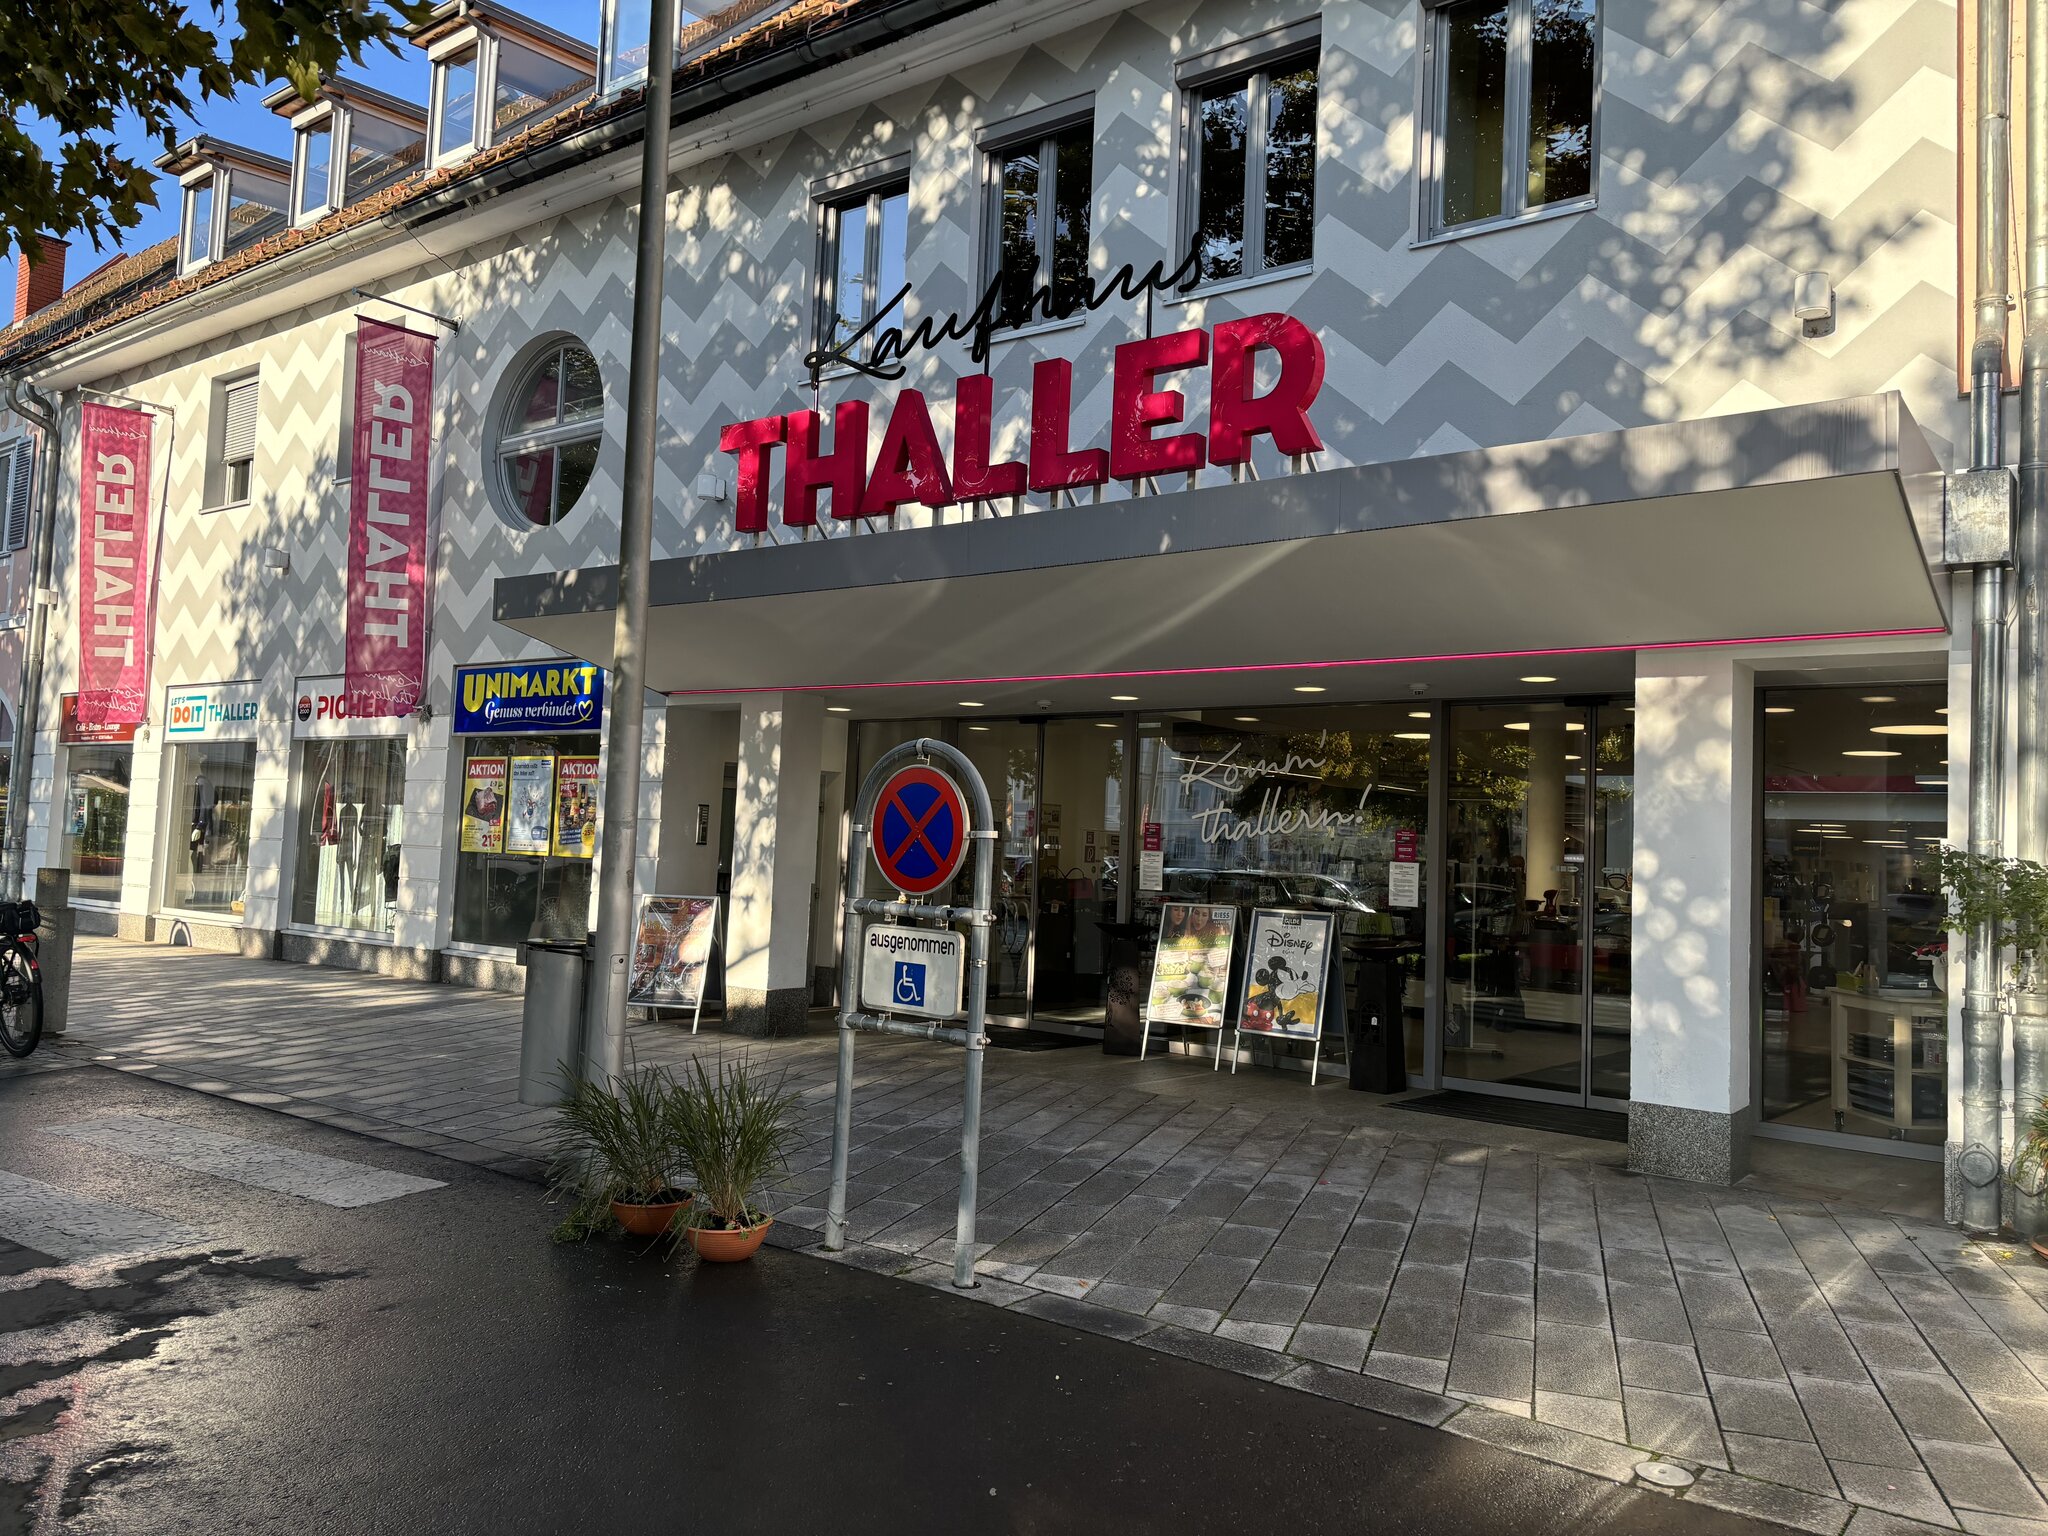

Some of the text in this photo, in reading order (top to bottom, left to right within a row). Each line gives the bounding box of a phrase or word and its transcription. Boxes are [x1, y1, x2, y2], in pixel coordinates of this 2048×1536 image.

[804, 231, 1201, 388] Kaufhaus
[720, 312, 1326, 534] THALLER
[463, 667, 598, 713] UNIMARKT
[208, 702, 259, 722] THALLER
[485, 701, 577, 724] Genuss verbindet
[469, 763, 504, 776] AKTION
[1213, 911, 1230, 919] RIESS
[870, 933, 955, 956] ausgenommen
